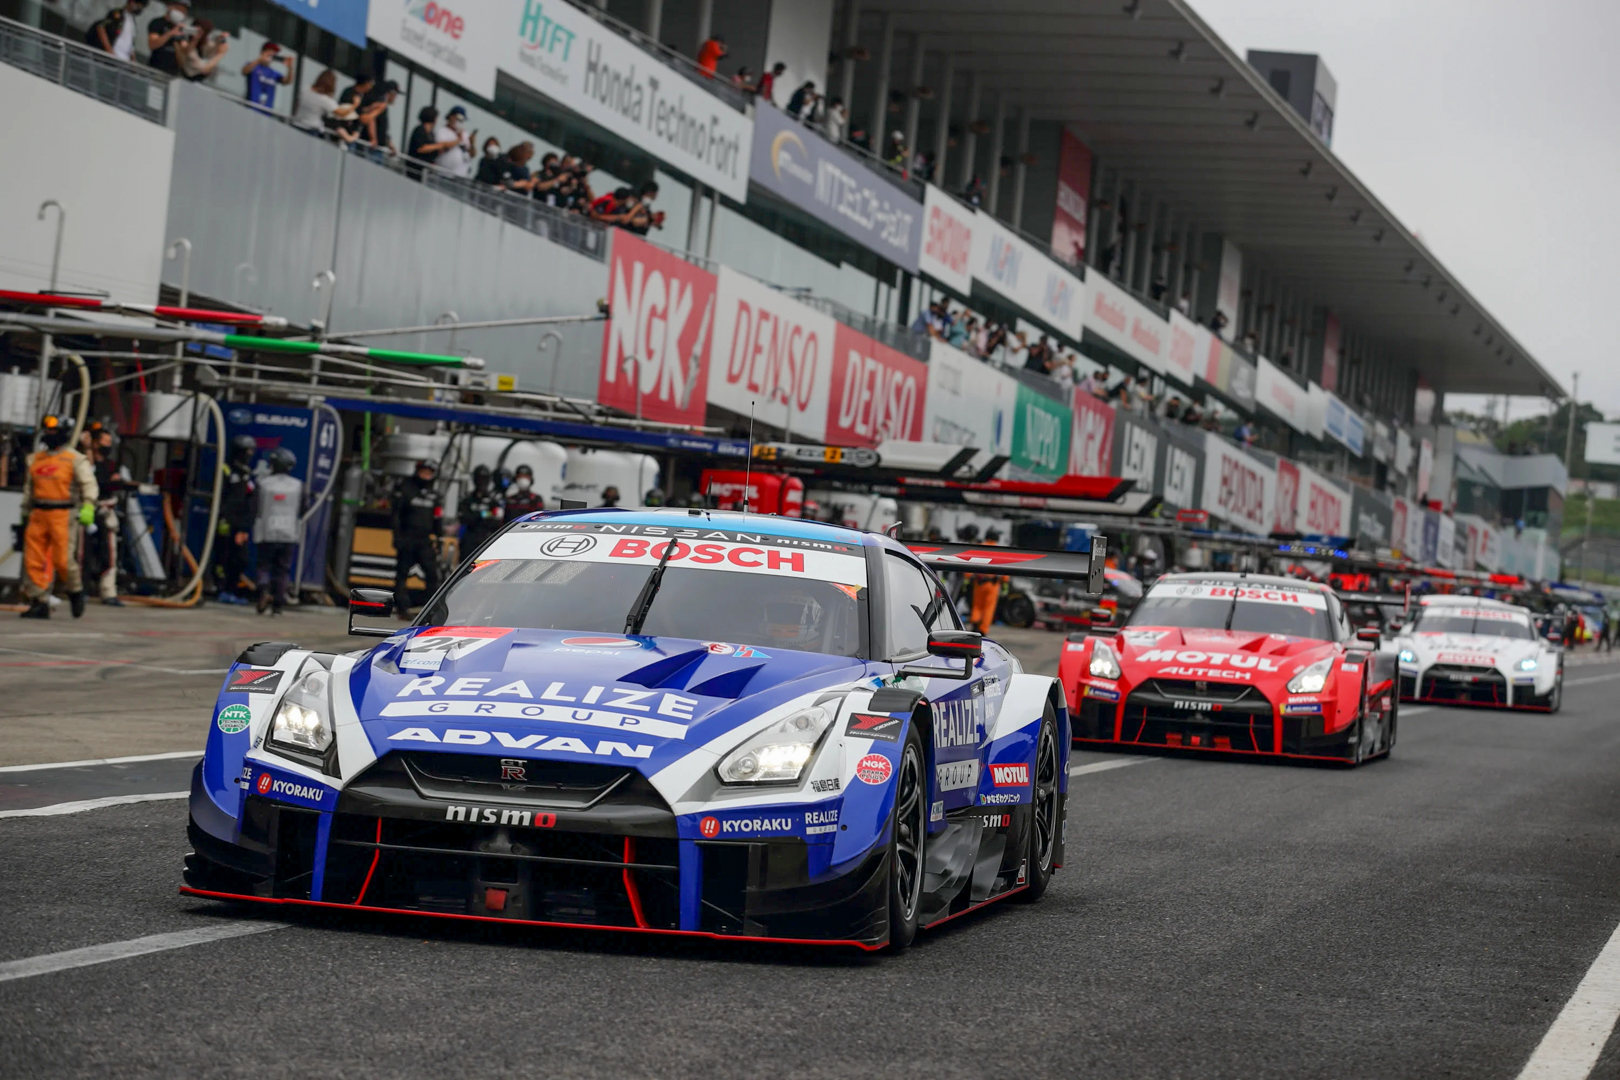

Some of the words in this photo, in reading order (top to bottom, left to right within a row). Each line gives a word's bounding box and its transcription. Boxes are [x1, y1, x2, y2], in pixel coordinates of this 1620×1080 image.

[424, 1, 465, 40] one
[584, 38, 644, 124] Honda
[605, 255, 694, 410] NGK
[726, 299, 819, 412] DENSO
[838, 349, 916, 442] DENSO
[255, 413, 308, 428] SUBARU
[1219, 454, 1265, 526] HONDA
[1306, 482, 1342, 537] HONDA
[599, 524, 762, 544] NISSAN
[776, 538, 849, 553] nismo
[608, 538, 806, 573] BOSCH
[1201, 579, 1277, 591] NISSAN
[1209, 587, 1299, 603] BOSCH
[553, 647, 621, 656] pepsi
[1136, 649, 1279, 671] MOTUL
[253, 671, 280, 685] YOKOHAMA
[1157, 666, 1252, 680] AUTECH
[395, 675, 699, 720] REALIZE
[1174, 700, 1223, 711] nismo
[224, 710, 248, 719] NTK
[428, 702, 641, 728] GROUP
[872, 718, 900, 732] YOKOHAMA
[931, 697, 980, 749] REALIZE
[387, 727, 655, 759] ADVAN
[862, 760, 887, 770] NGK
[937, 764, 972, 785] GROUP
[993, 766, 1029, 784] MOTUL
[272, 780, 324, 802] KYORAKU
[811, 778, 841, 793] 福島日産
[445, 805, 557, 829] nismo
[722, 818, 792, 833] KYORAKU
[805, 809, 838, 825] REALIZE
